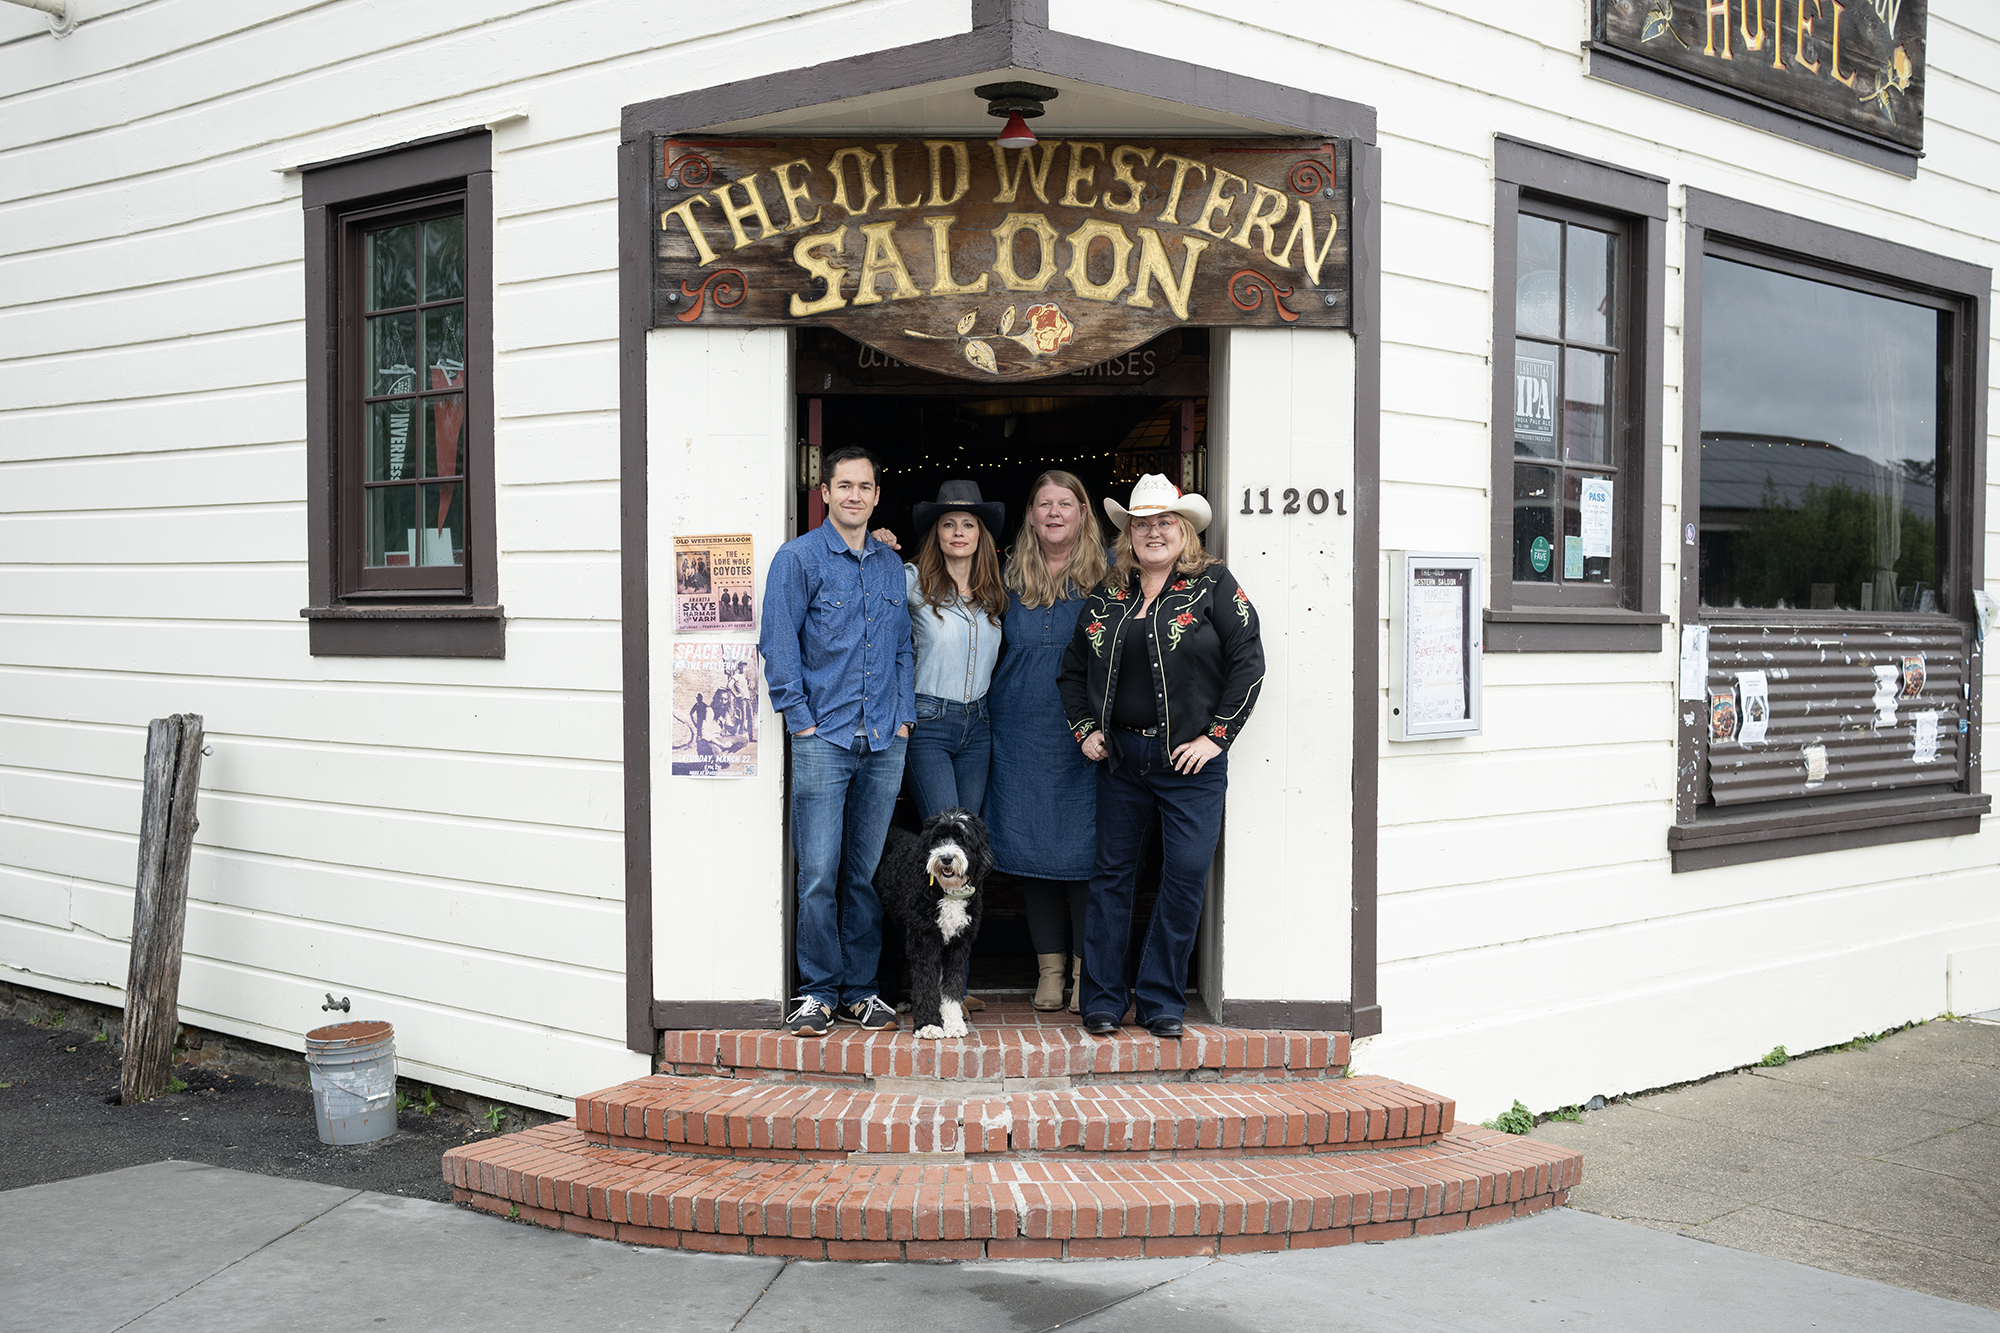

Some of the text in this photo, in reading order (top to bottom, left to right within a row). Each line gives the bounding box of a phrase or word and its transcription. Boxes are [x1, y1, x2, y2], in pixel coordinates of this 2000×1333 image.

[661, 141, 1340, 286] THE OLD WESTERN
[789, 212, 1209, 320] SALOON
[1519, 362, 1549, 378] LAGUNITAS
[1516, 375, 1550, 419] IPA
[1529, 418, 1540, 426] PALE
[390, 413, 410, 480] INVERNESS
[1240, 487, 1347, 516] 11201
[1589, 492, 1605, 502] PASS
[1534, 552, 1547, 561] FAVE
[713, 566, 752, 576] COYOTES
[1438, 578, 1456, 586] SALOON
[1424, 589, 1450, 601] MARCH
[683, 602, 716, 611] SKYE
[676, 644, 755, 660] SPACE SUIT
[687, 662, 700, 670] THE
[703, 661, 736, 670] WESTERN
[677, 754, 714, 763] SATURDAY,
[715, 755, 740, 763] MARCH
